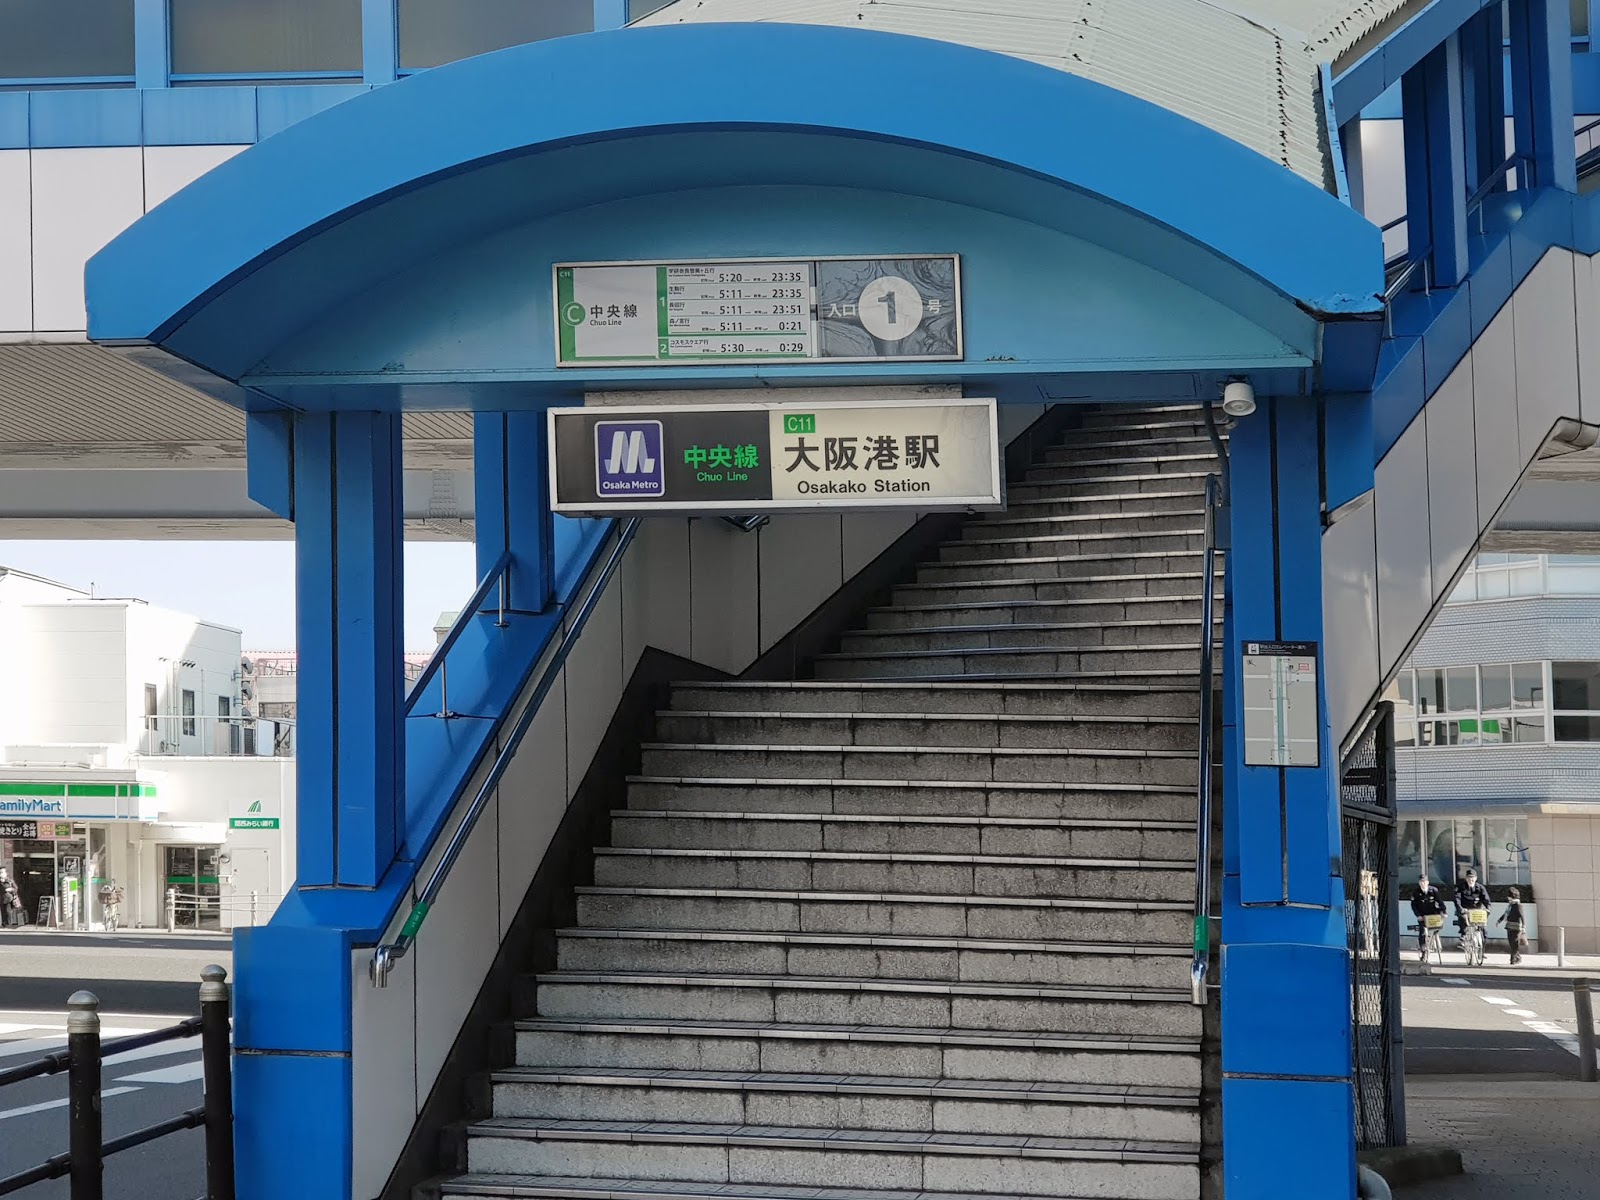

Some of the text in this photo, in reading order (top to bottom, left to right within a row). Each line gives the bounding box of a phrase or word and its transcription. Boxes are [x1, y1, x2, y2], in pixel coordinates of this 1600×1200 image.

[719, 272, 801, 283] 5:20 23:35
[719, 288, 802, 299] 5:11 23:35
[659, 296, 665, 307] 1
[590, 304, 638, 318] 中央線
[719, 304, 801, 315] 5:11 23:51
[828, 291, 942, 324] 入口 1 号
[566, 305, 580, 322] C
[720, 322, 742, 331] 5:11
[779, 321, 801, 331] 0:21
[660, 344, 667, 353] 2
[721, 342, 803, 353] 5:30 0:29
[787, 416, 812, 432] C11
[684, 444, 760, 470] 中央線
[784, 435, 941, 473] 大阪港駅
[696, 471, 748, 482] Chuo Line
[602, 480, 659, 490] Osaka Metro
[797, 478, 931, 494] Osakako Station
[0, 799, 62, 812] amilyMart
